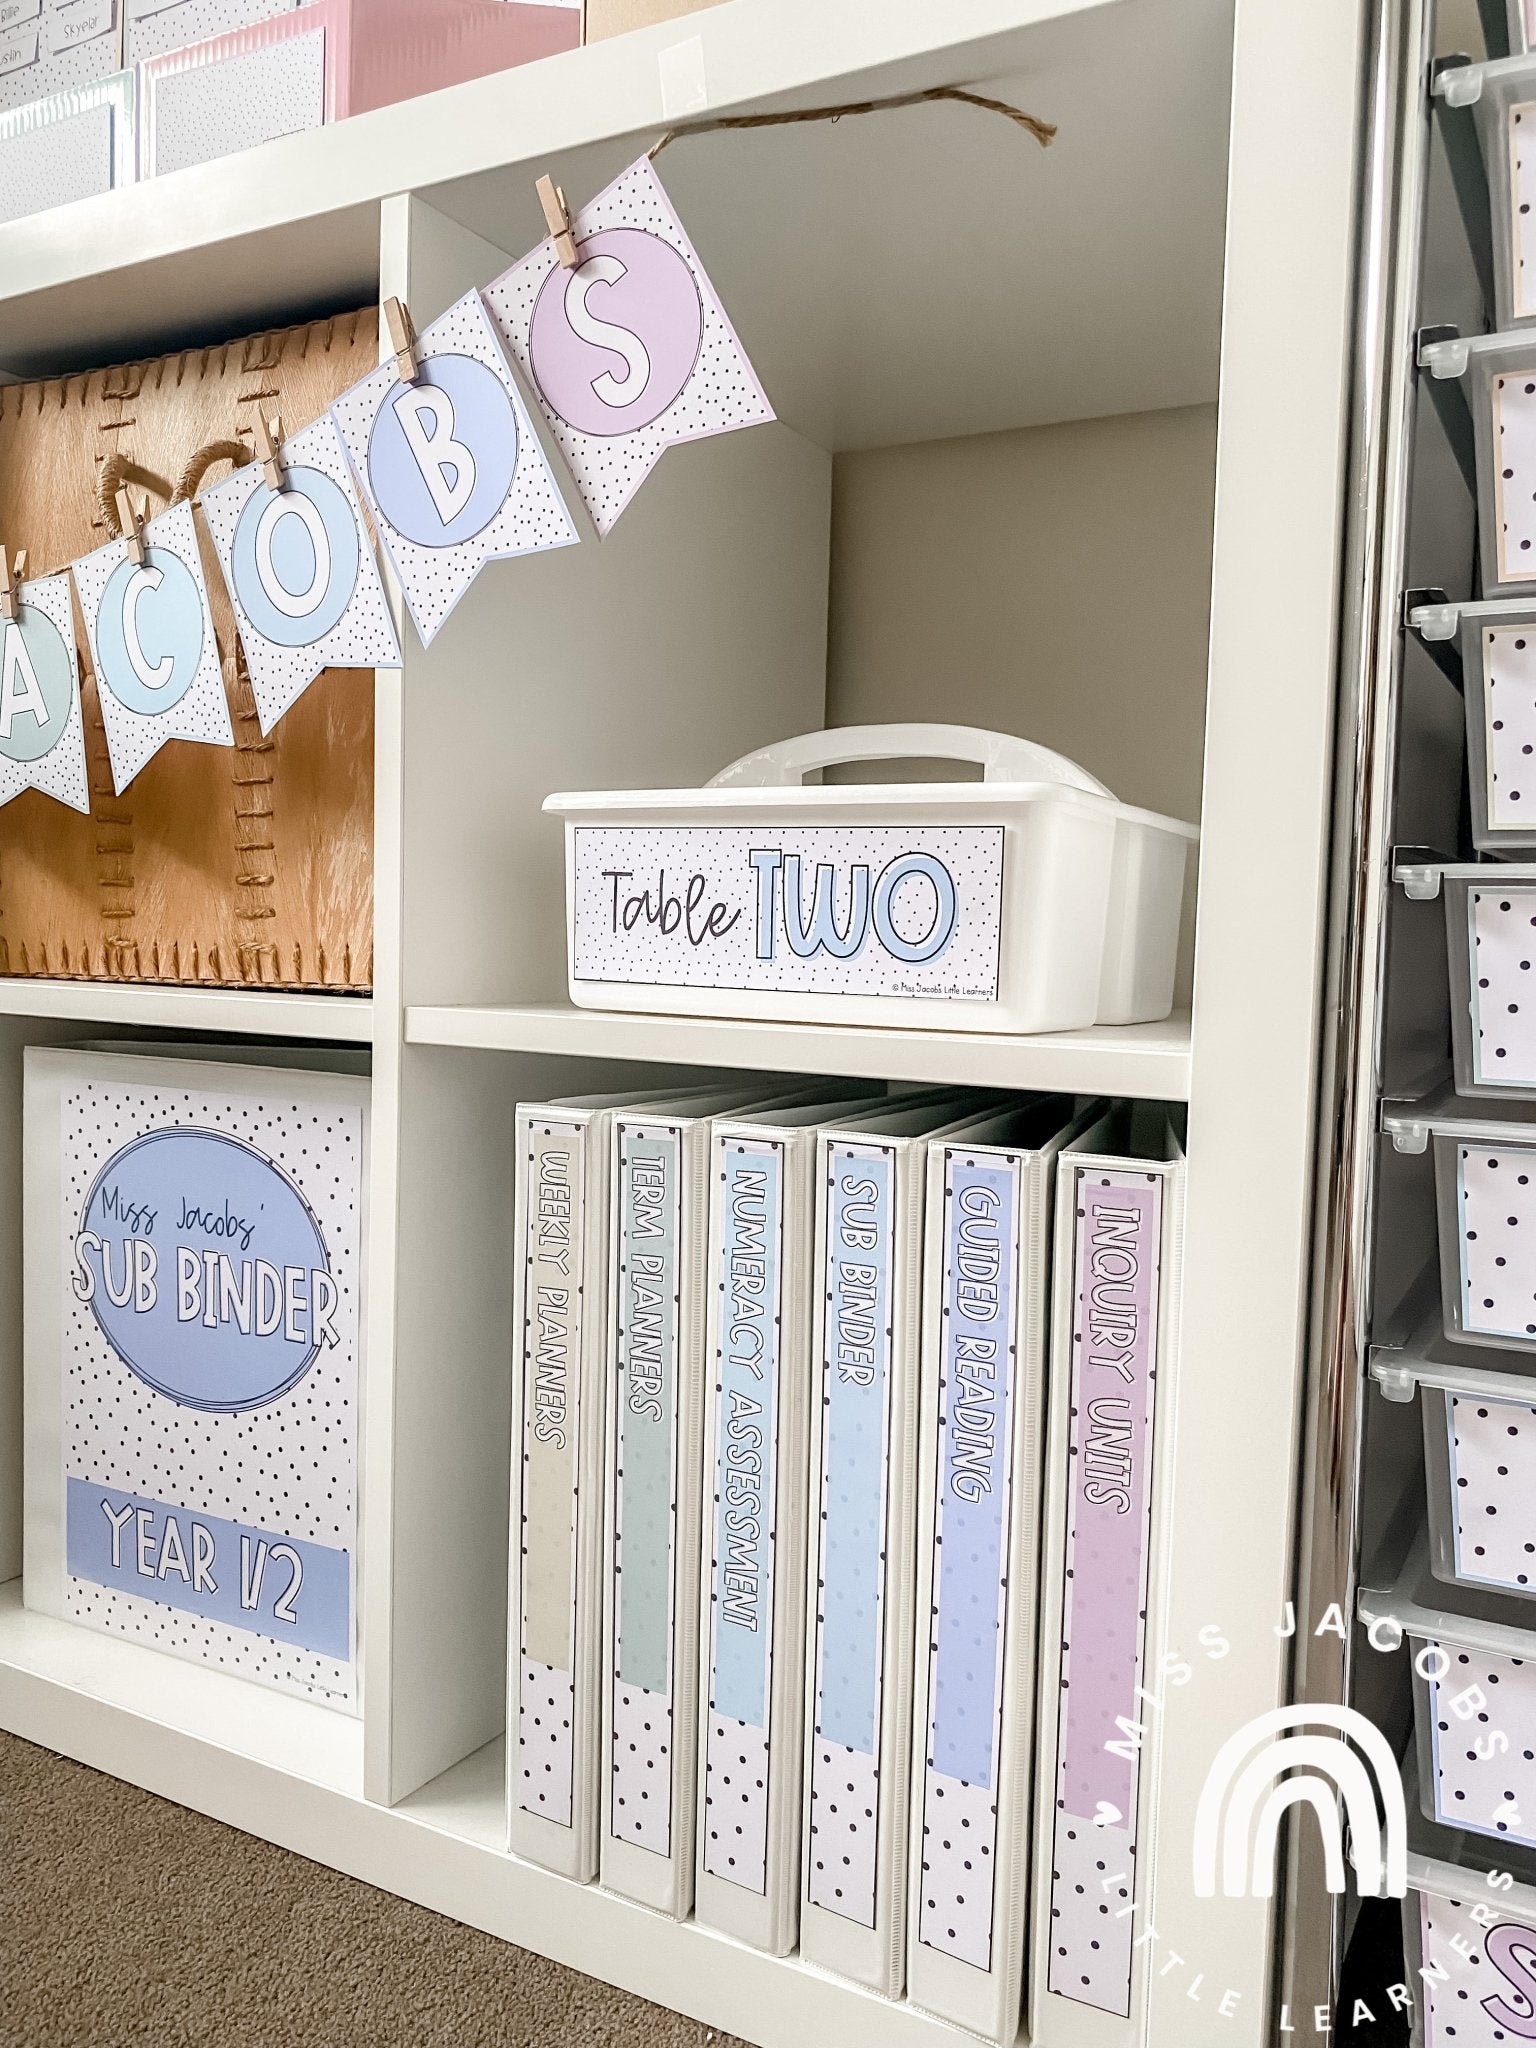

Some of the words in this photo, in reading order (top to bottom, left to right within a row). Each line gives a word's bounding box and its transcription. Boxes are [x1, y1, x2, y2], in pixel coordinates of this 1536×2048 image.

[601, 868, 742, 946] Table
[749, 849, 960, 967] TWO
[916, 984, 942, 994] Jacobs
[944, 986, 960, 995] Little
[962, 986, 994, 997] Learners
[101, 1185, 159, 1236] Miss
[537, 1151, 571, 1276] WEEKLY
[631, 1155, 666, 1240] TERM
[839, 1175, 880, 1252] SUB
[956, 1184, 1002, 1323] GUIDED
[71, 1230, 159, 1314] SUB
[176, 1246, 342, 1350] BINDER
[628, 1253, 665, 1423] PLANNERS
[729, 1169, 768, 1382] NUMERACY
[836, 1260, 878, 1388] BINDER
[1087, 1204, 1142, 1384] INQUIRY
[534, 1286, 569, 1451] PLANNERS
[950, 1334, 998, 1505] READING
[722, 1390, 764, 1633] ASSESSMENT
[1083, 1397, 1134, 1516] UNITS
[100, 1498, 219, 1595] YEAR
[240, 1534, 304, 1625] 1/2
